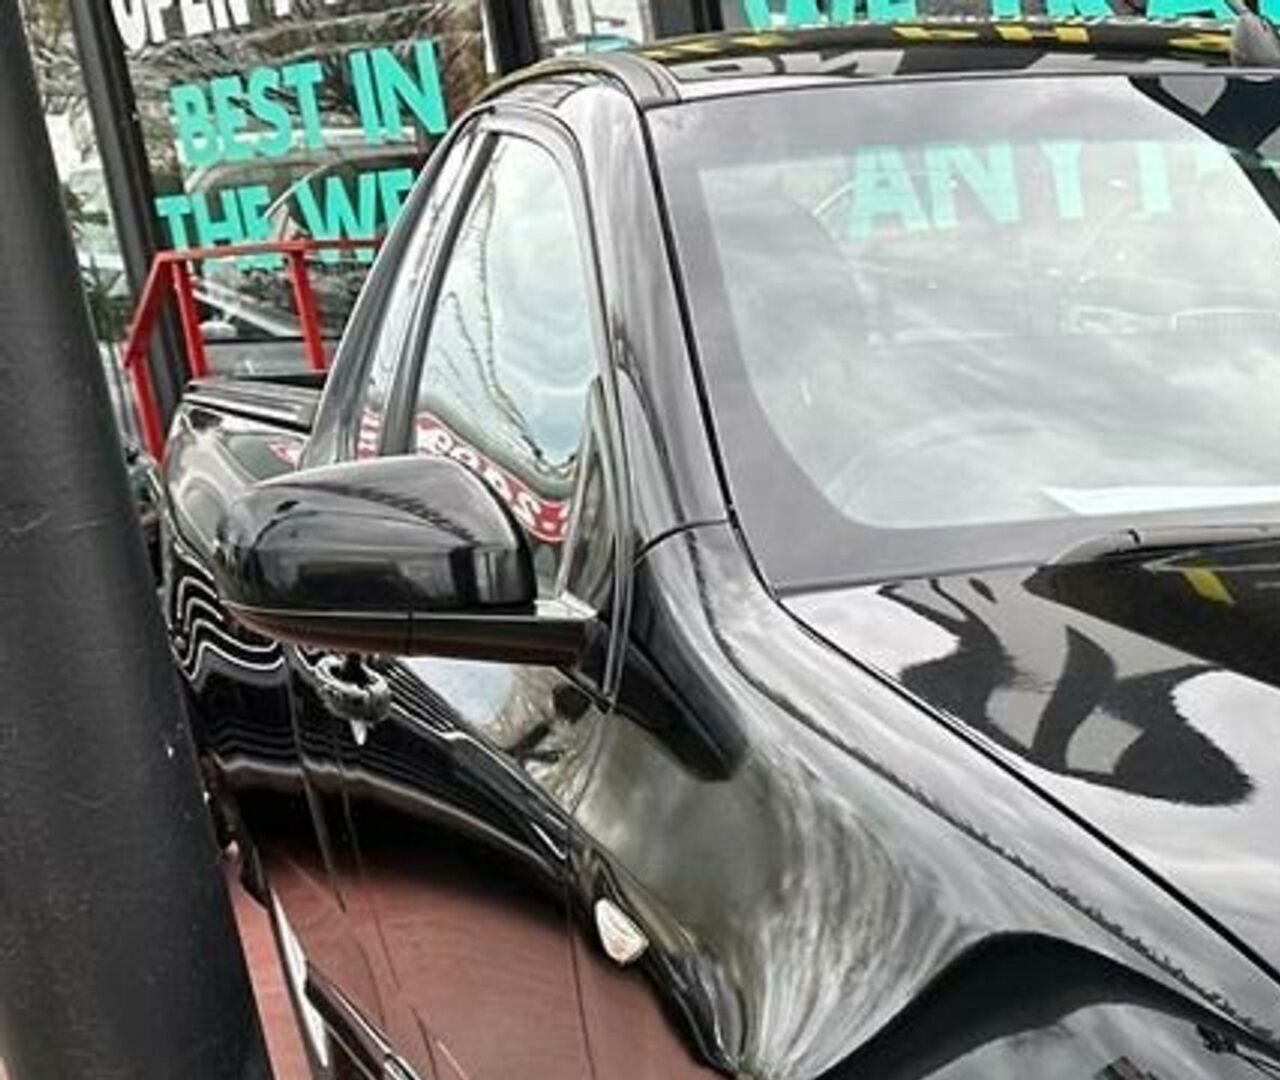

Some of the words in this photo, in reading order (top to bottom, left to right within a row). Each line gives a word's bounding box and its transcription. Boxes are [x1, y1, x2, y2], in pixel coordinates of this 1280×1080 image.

[171, 62, 326, 168] BEST
[349, 38, 449, 146] IN
[154, 185, 284, 271] THE
